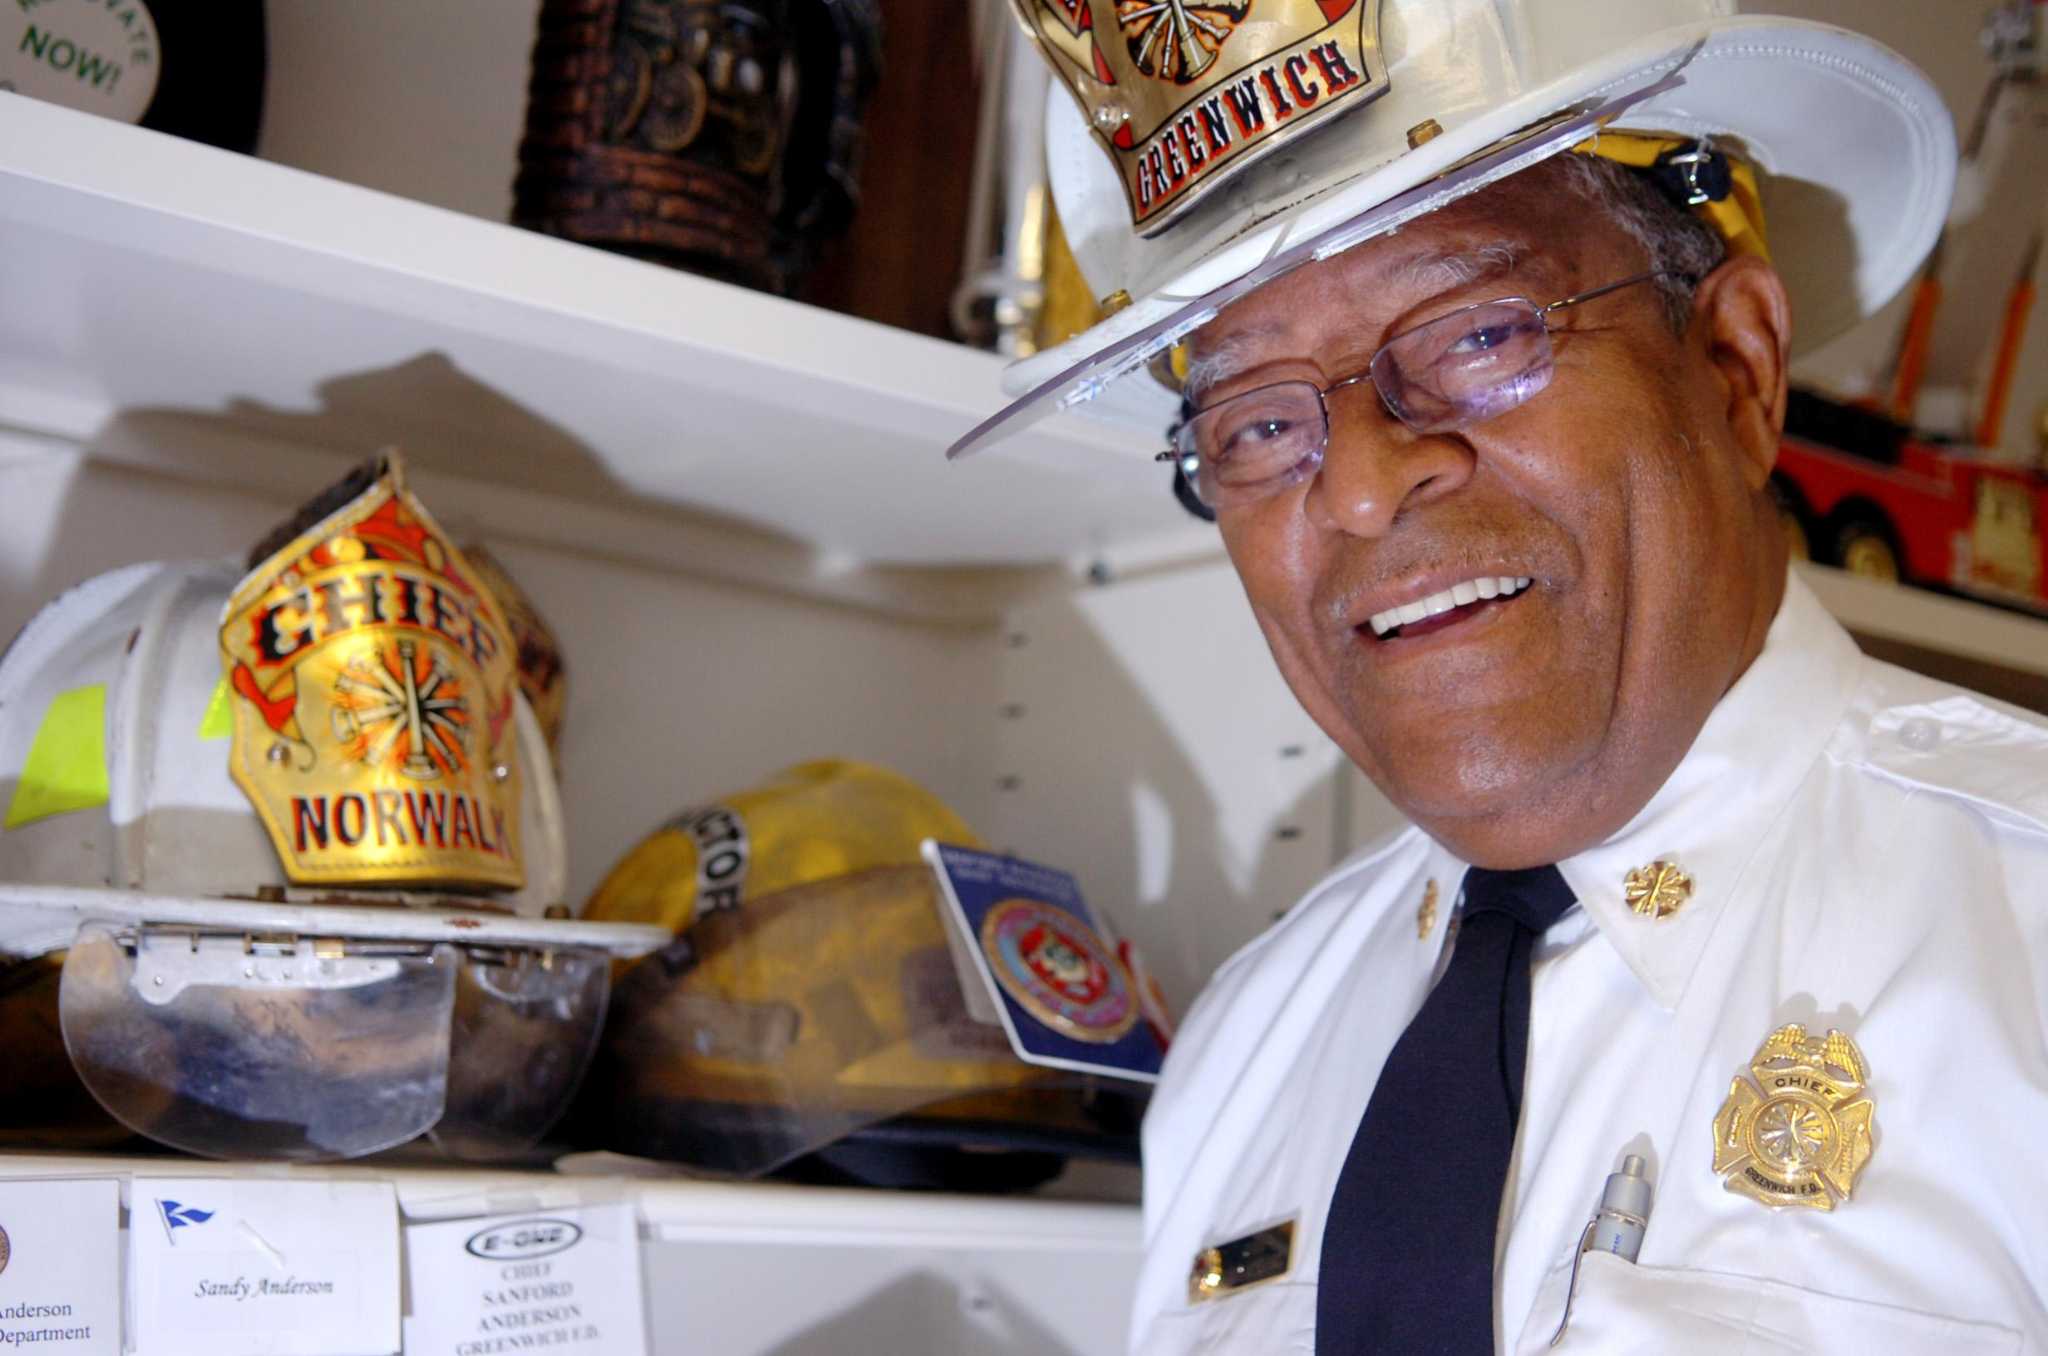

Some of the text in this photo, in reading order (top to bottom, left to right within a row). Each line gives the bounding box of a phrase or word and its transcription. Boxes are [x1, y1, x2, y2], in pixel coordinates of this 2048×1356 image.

[19, 23, 122, 95] NOW!
[1137, 39, 1359, 215] GREENWICH
[252, 572, 497, 668] CHIEF
[291, 789, 511, 860] NORWALK
[1775, 1077, 1834, 1096] CHIEF
[194, 1275, 334, 1302] Sandy Anderson
[482, 1281, 573, 1306] SANFORD
[480, 1304, 582, 1331] ANDERSON
